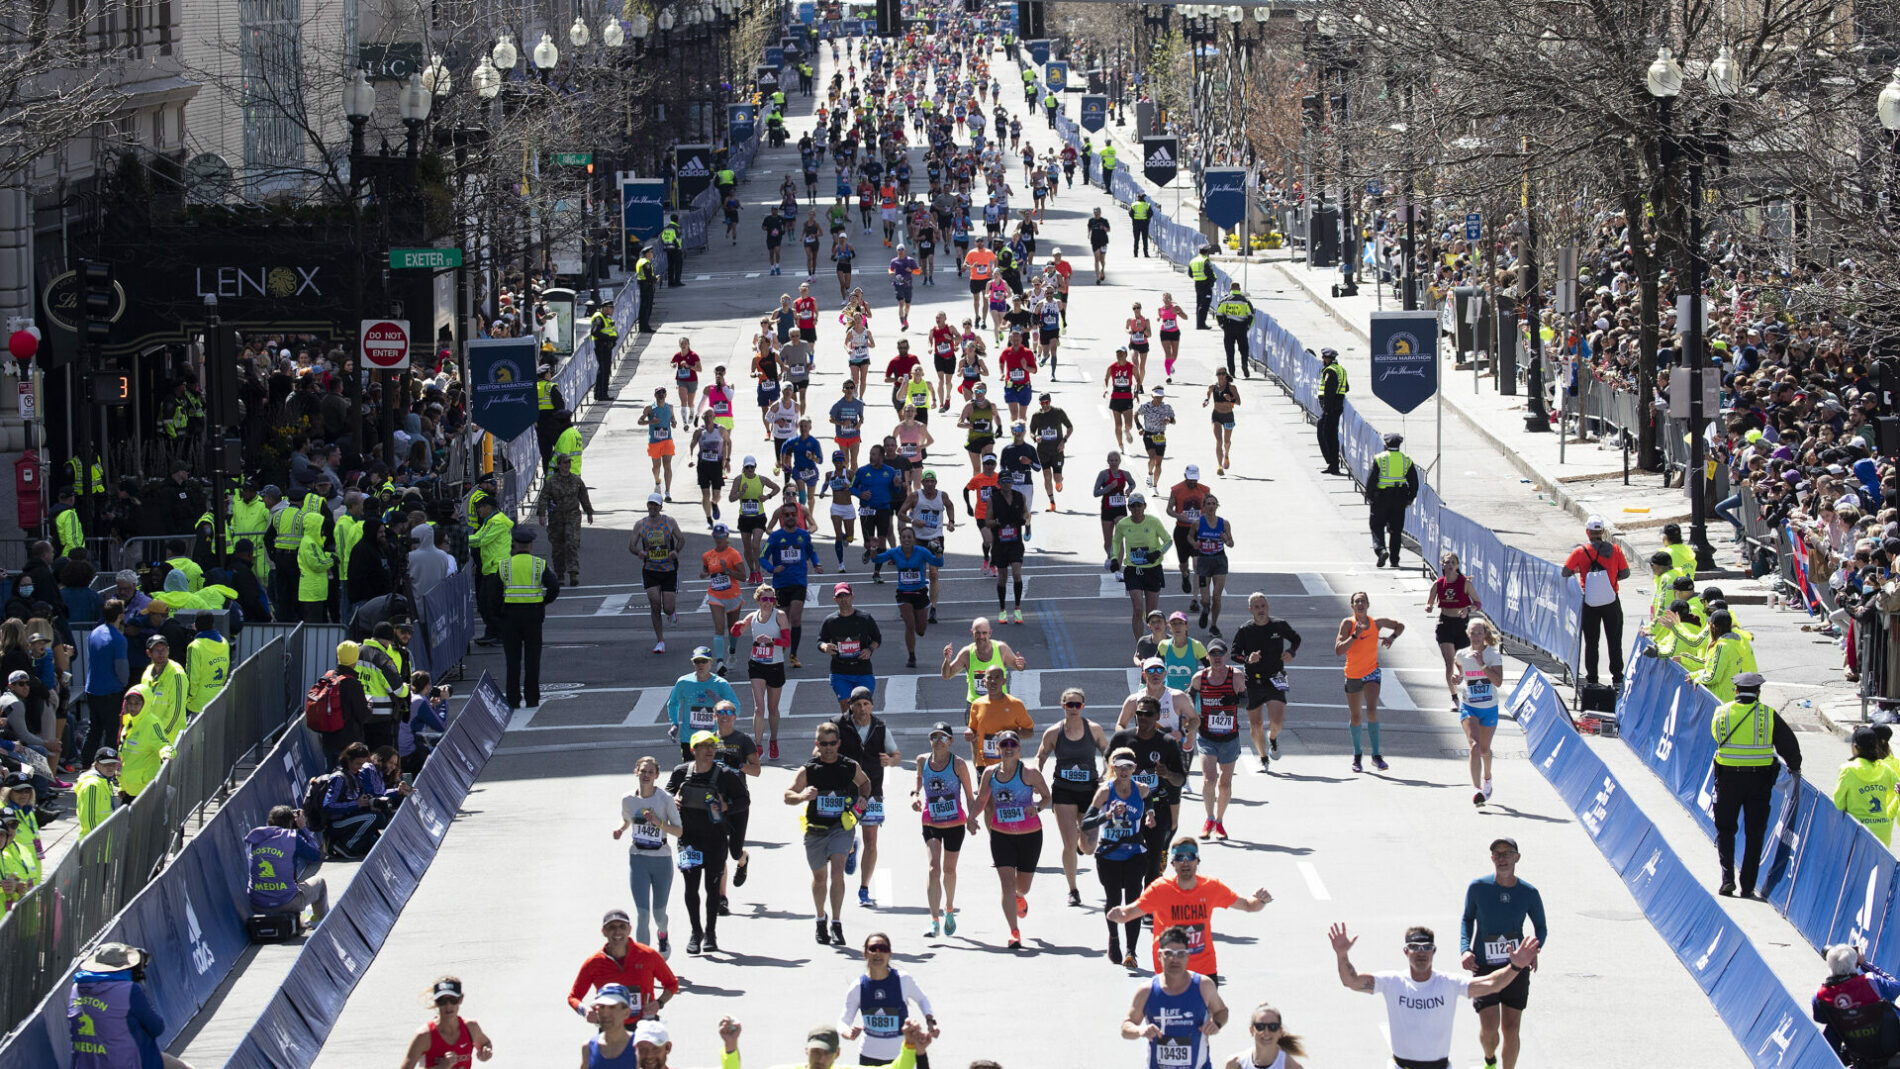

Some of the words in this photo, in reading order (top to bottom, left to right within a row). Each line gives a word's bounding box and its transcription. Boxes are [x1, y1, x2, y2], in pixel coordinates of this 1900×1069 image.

[1145, 160, 1176, 168] adidas
[678, 169, 710, 177] adidas
[405, 252, 444, 267] EXETER
[196, 265, 322, 297] LENOX
[369, 331, 381, 340] DO
[385, 331, 402, 340] NOT
[119, 376, 128, 398] 3
[1211, 716, 1232, 726] 14278
[1064, 770, 1088, 781] 19996
[1858, 784, 1887, 795] BOSTON
[636, 824, 661, 838] 14428
[254, 881, 288, 892] MEDIA
[1398, 995, 1445, 1010] FUSION
[1166, 1008, 1180, 1017] LIFE
[865, 1015, 896, 1028] 16891
[73, 1042, 107, 1055] MEDIA
[1159, 1045, 1188, 1061] 13439
